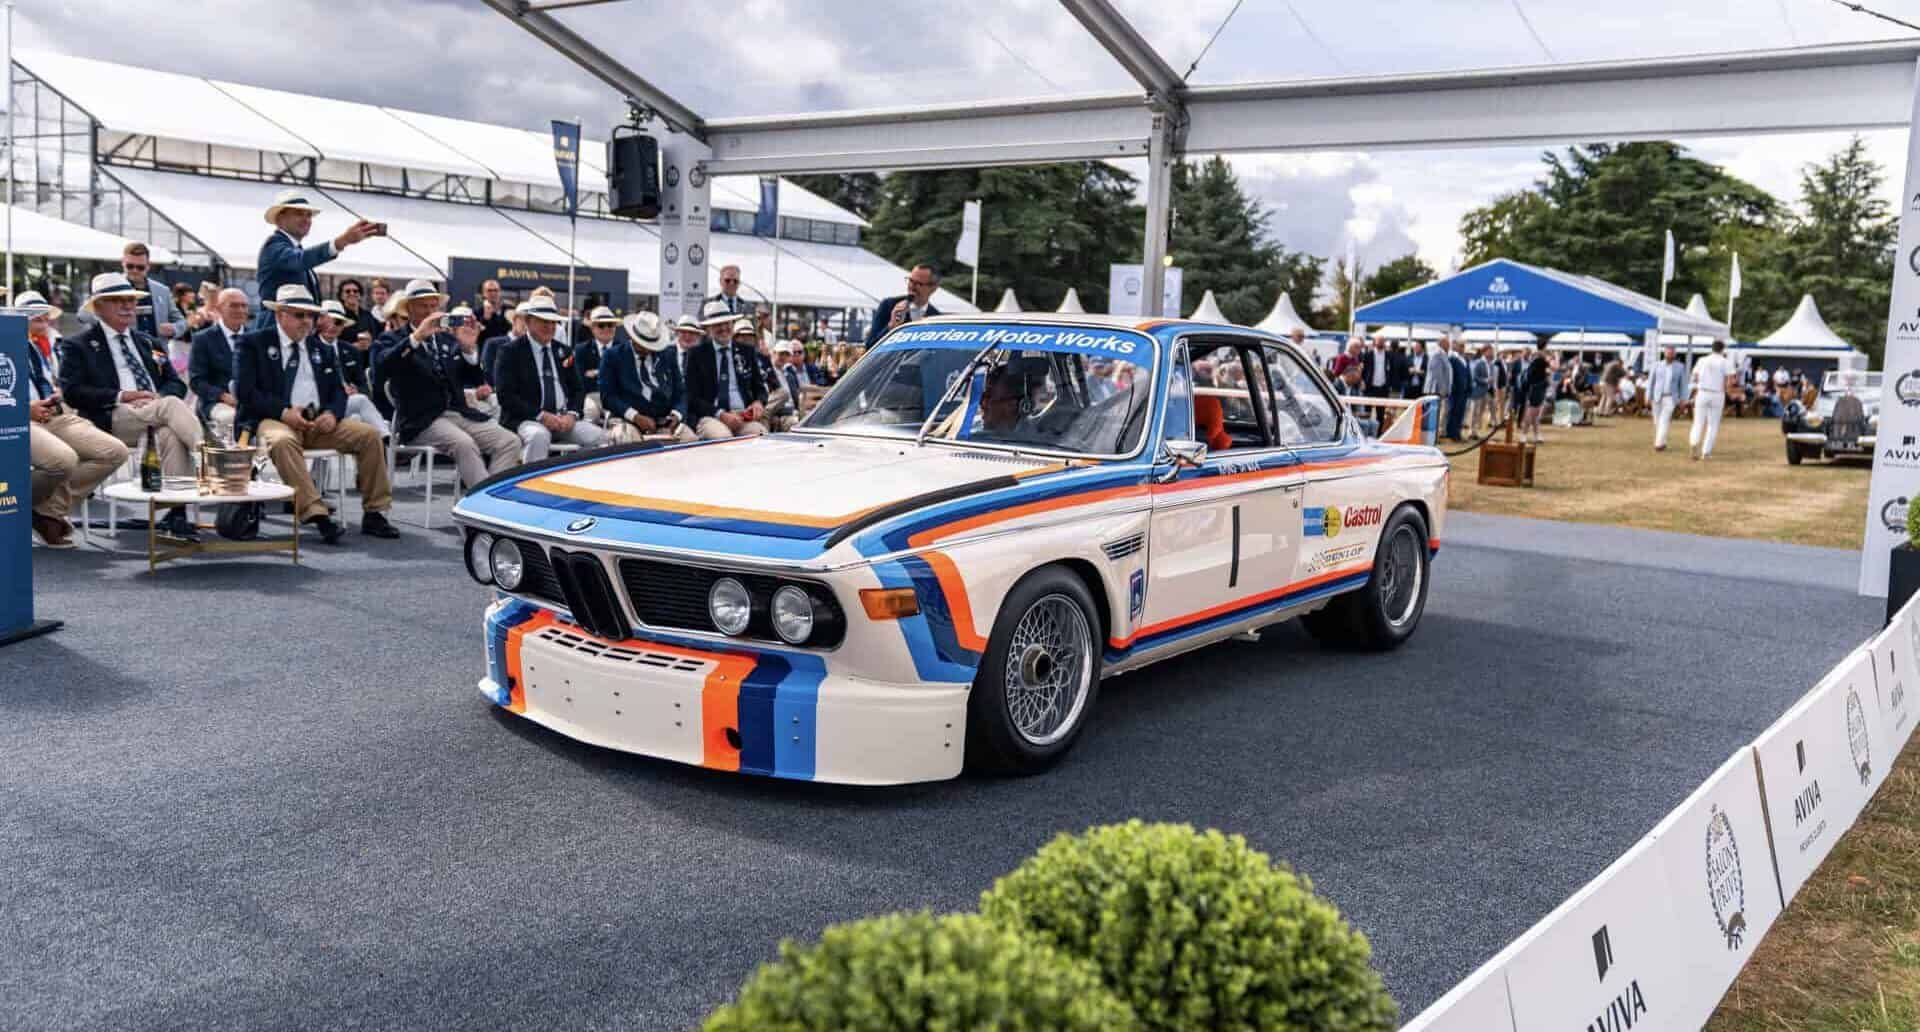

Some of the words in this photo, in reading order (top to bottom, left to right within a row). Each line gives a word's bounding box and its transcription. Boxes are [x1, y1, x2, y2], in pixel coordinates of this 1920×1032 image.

[1468, 298, 1528, 312] POMMERY
[883, 329, 978, 345] Bavarian
[979, 329, 1055, 345] Motor
[1055, 331, 1137, 354] Works
[1884, 448, 1920, 461] AVIV
[1344, 503, 1382, 528] Castrol
[1794, 778, 1822, 830] AVIVA
[1586, 978, 1648, 1032] VIVA
